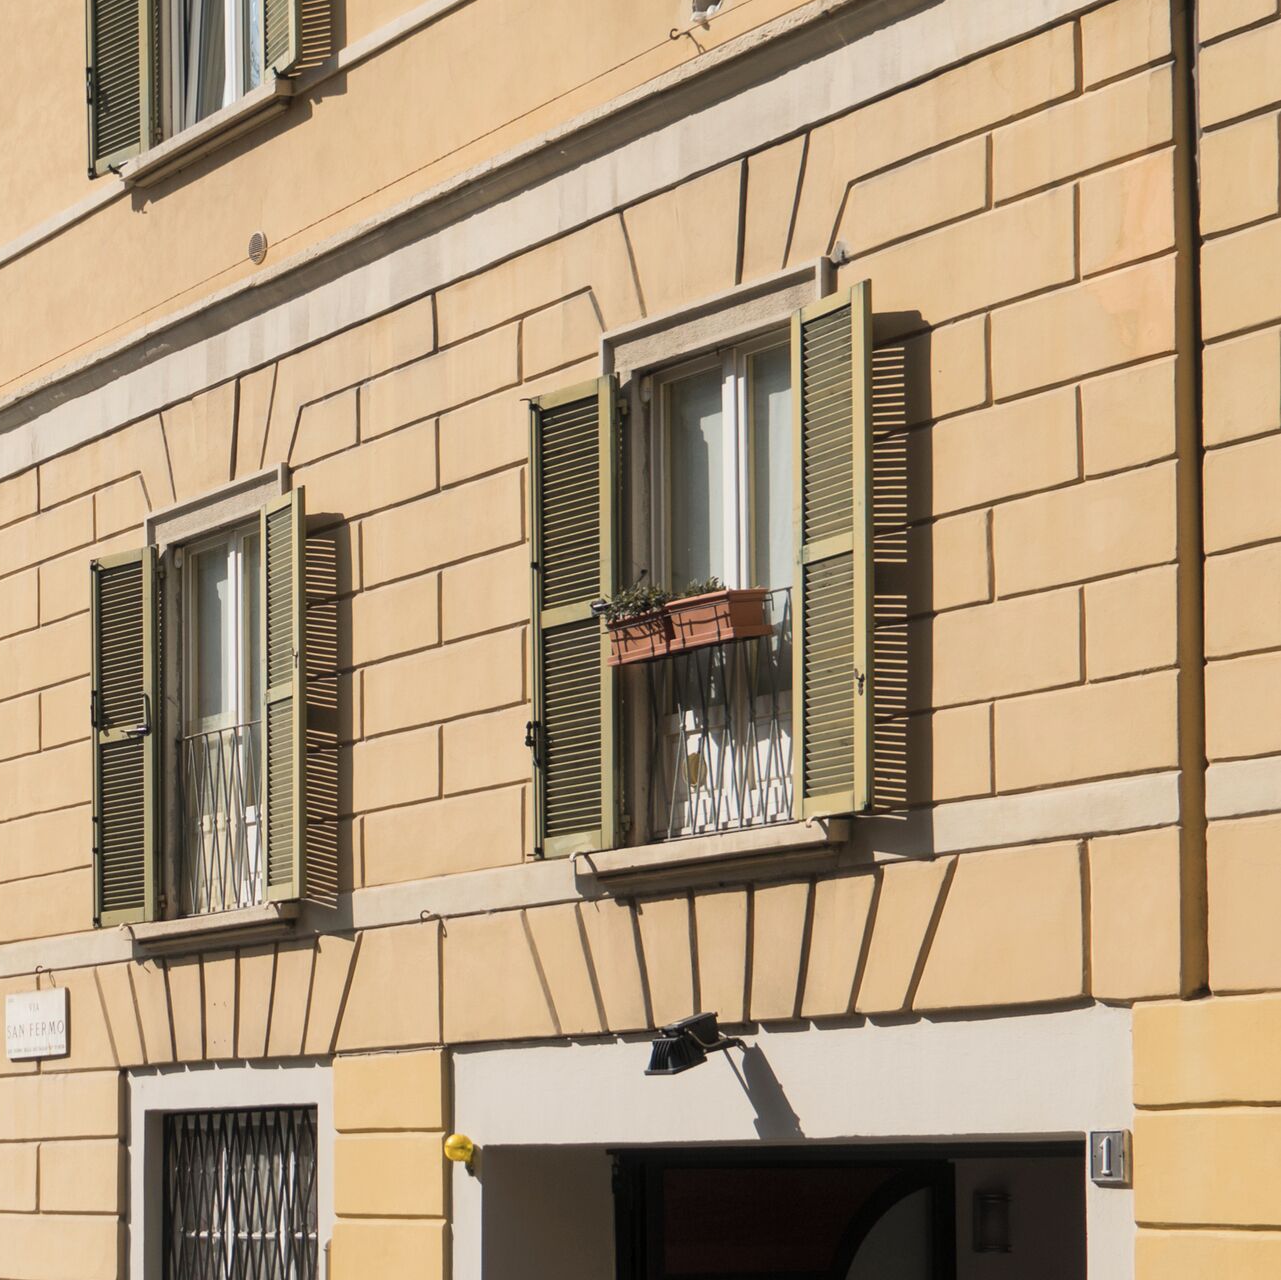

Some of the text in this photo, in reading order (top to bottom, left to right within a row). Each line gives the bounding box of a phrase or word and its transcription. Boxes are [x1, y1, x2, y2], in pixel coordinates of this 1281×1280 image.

[29, 1002, 40, 1013] VIA
[7, 1019, 65, 1039] SAN FERMO
[1099, 1136, 1113, 1176] 1
